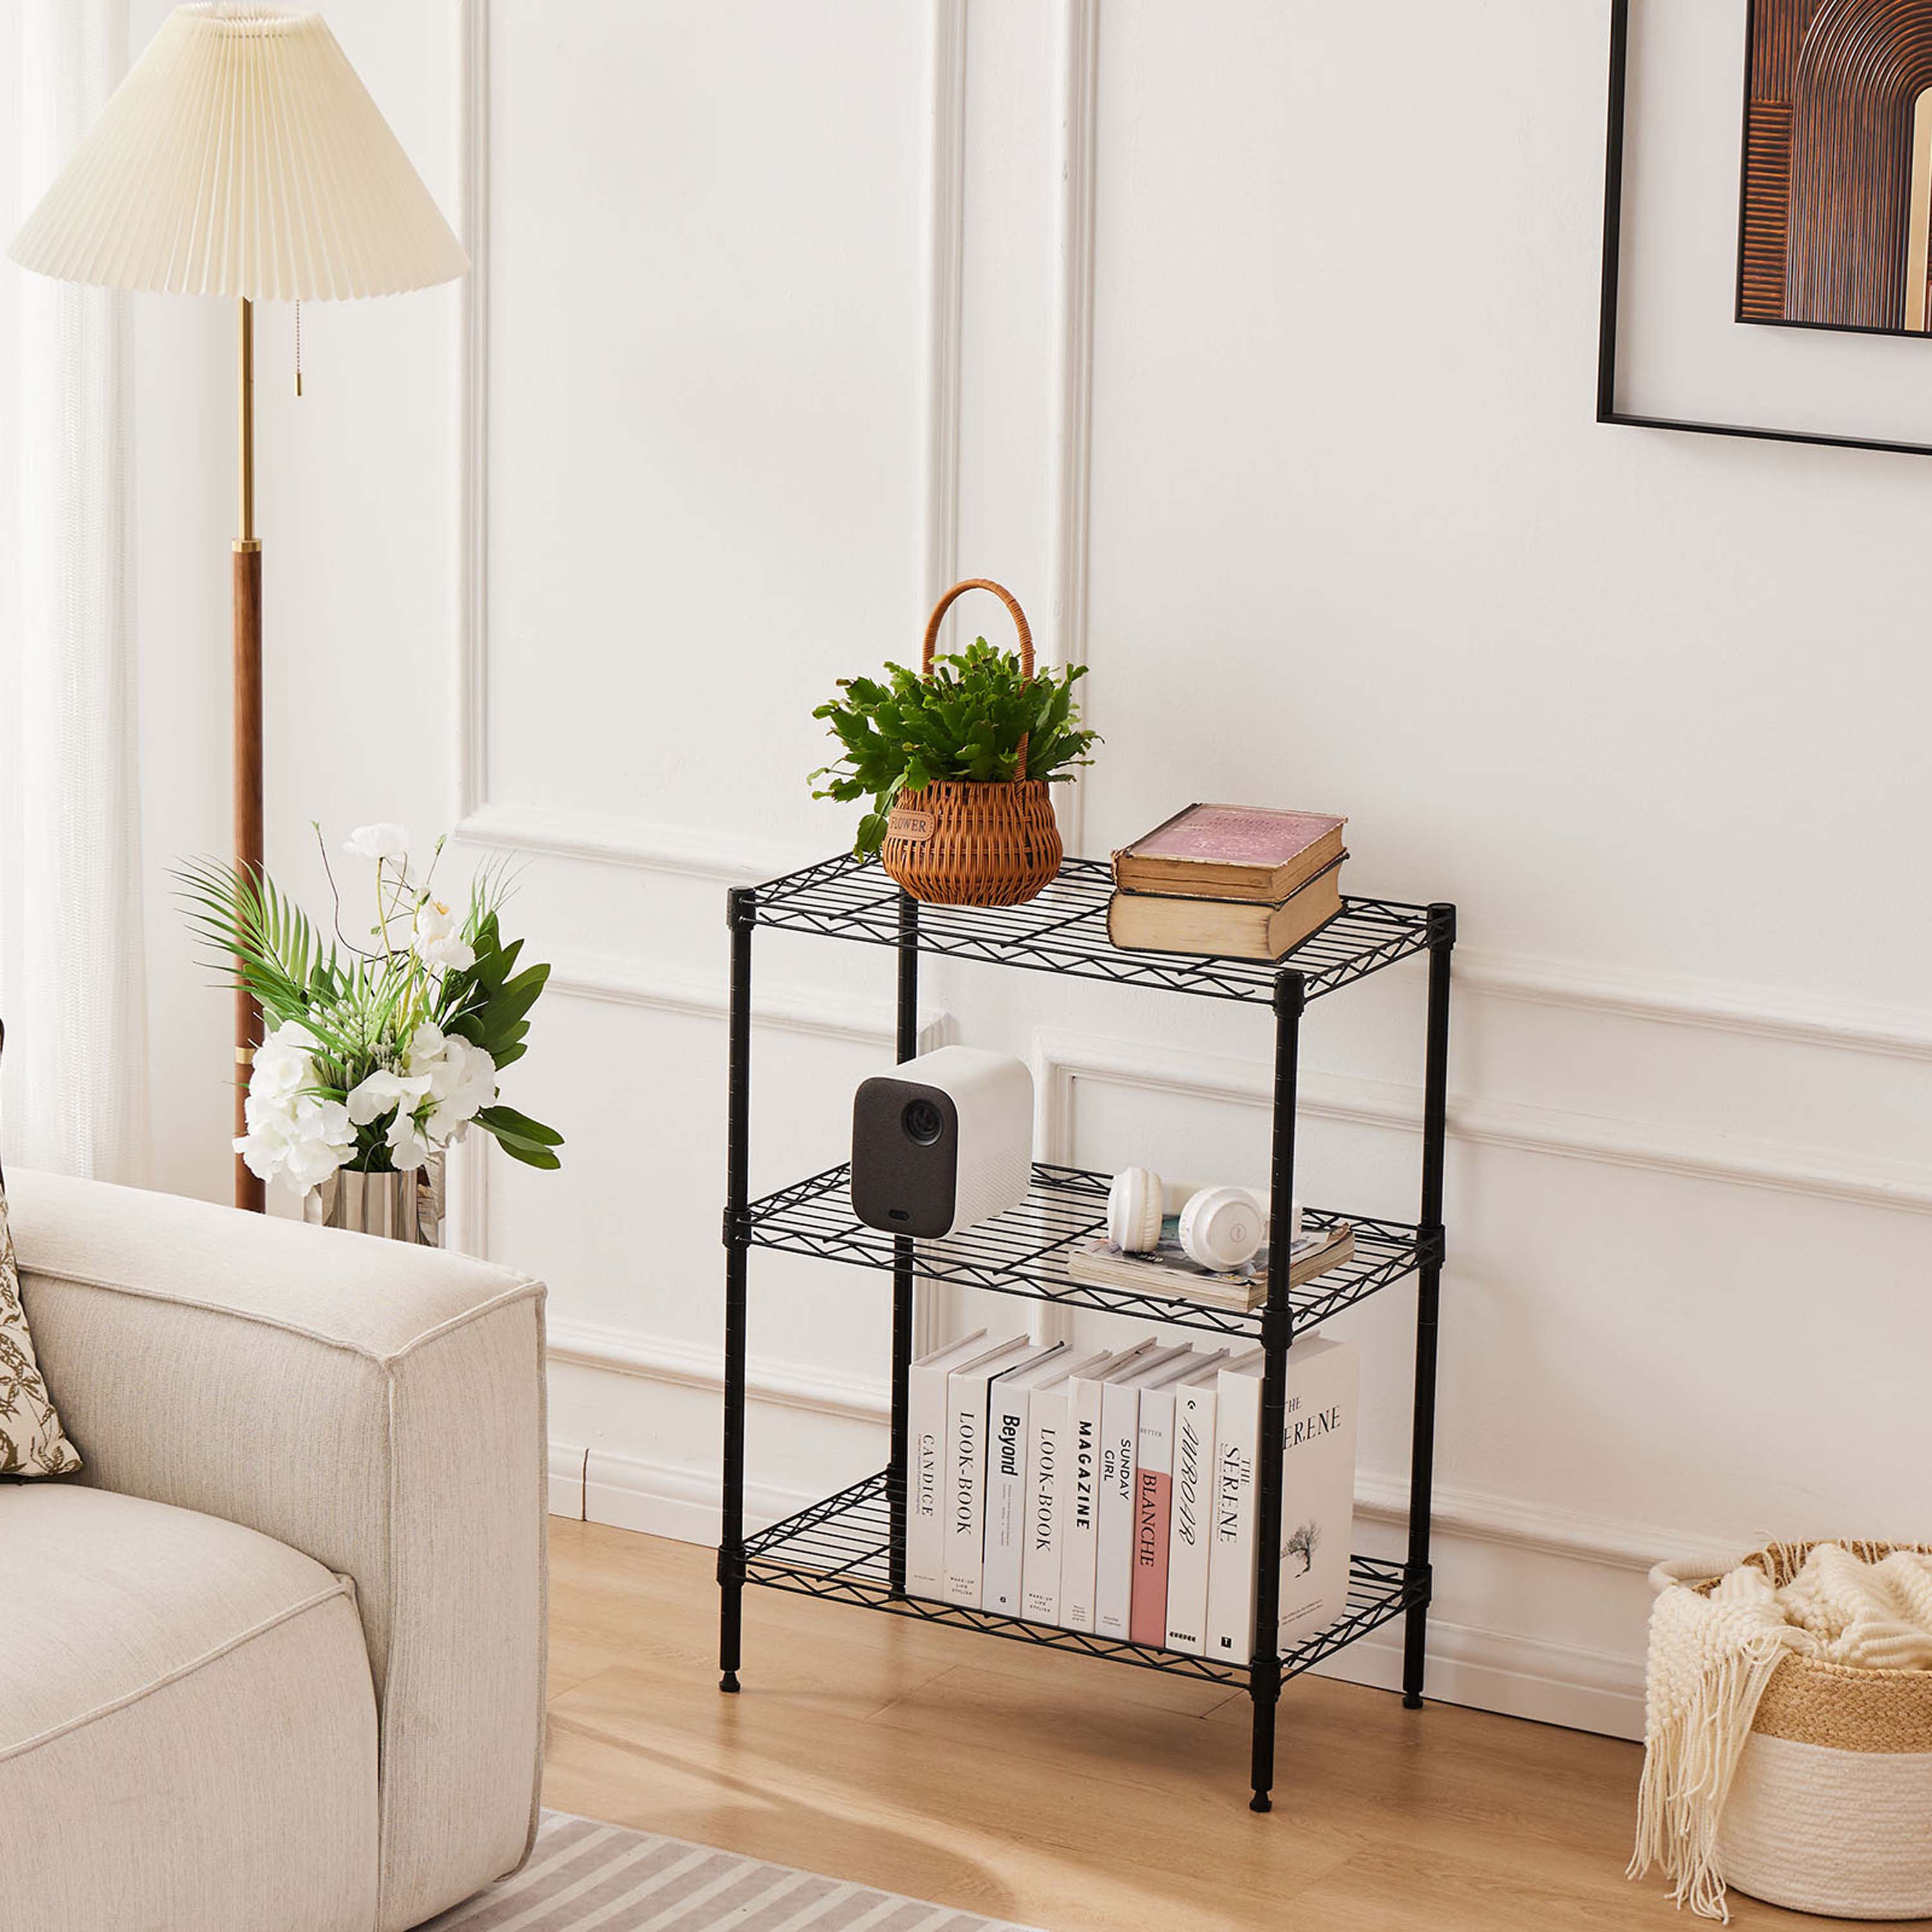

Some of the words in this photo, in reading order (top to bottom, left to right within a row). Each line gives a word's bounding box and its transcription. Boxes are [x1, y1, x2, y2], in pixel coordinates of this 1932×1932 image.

[891, 817, 926, 833] FLOWER
[1283, 1405, 1341, 1450] ERENE
[1286, 1396, 1302, 1413] HE
[922, 1434, 934, 1517] CANDICE
[956, 1412, 974, 1535] LOOK-BOOK
[998, 1414, 1020, 1476] Beyond
[1077, 1421, 1092, 1530] MAGAZINE
[1104, 1450, 1115, 1481] GIRL
[1119, 1439, 1131, 1501] SUNDAY
[1240, 1458, 1251, 1486] THE
[1036, 1428, 1056, 1551] LOOK-BOOK
[1140, 1473, 1157, 1567] BLANCHE
[1220, 1443, 1241, 1544] SERENE
